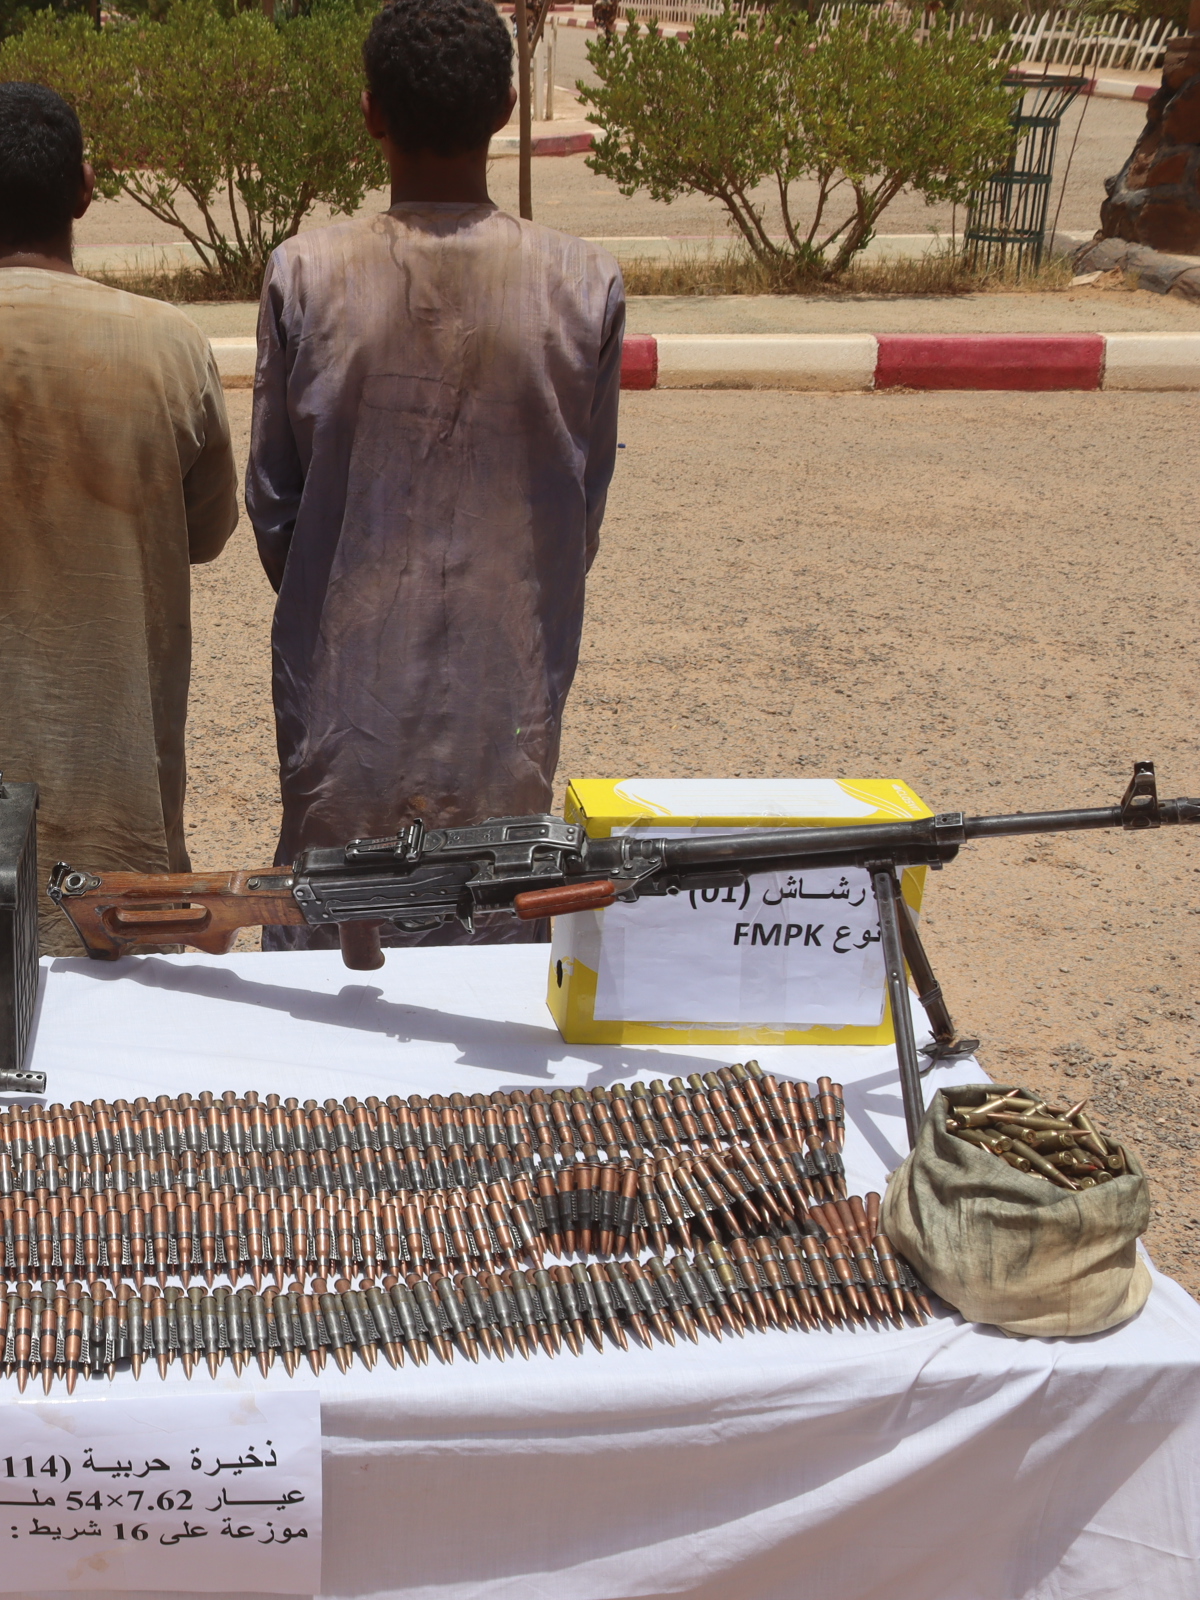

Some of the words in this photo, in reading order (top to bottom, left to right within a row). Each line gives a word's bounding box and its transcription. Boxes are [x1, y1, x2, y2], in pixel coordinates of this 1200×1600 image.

[761, 875, 866, 907] رشاش
[733, 923, 825, 946] FMPK
[833, 921, 882, 954] نوع
[83, 1448, 170, 1478] حربية
[191, 1440, 276, 1476] ذخيرة
[206, 1488, 304, 1511] عيار
[29, 1518, 101, 1540] شريط
[115, 1523, 148, 1540] 16
[160, 1521, 208, 1545] على
[221, 1517, 308, 1544] موزعة
